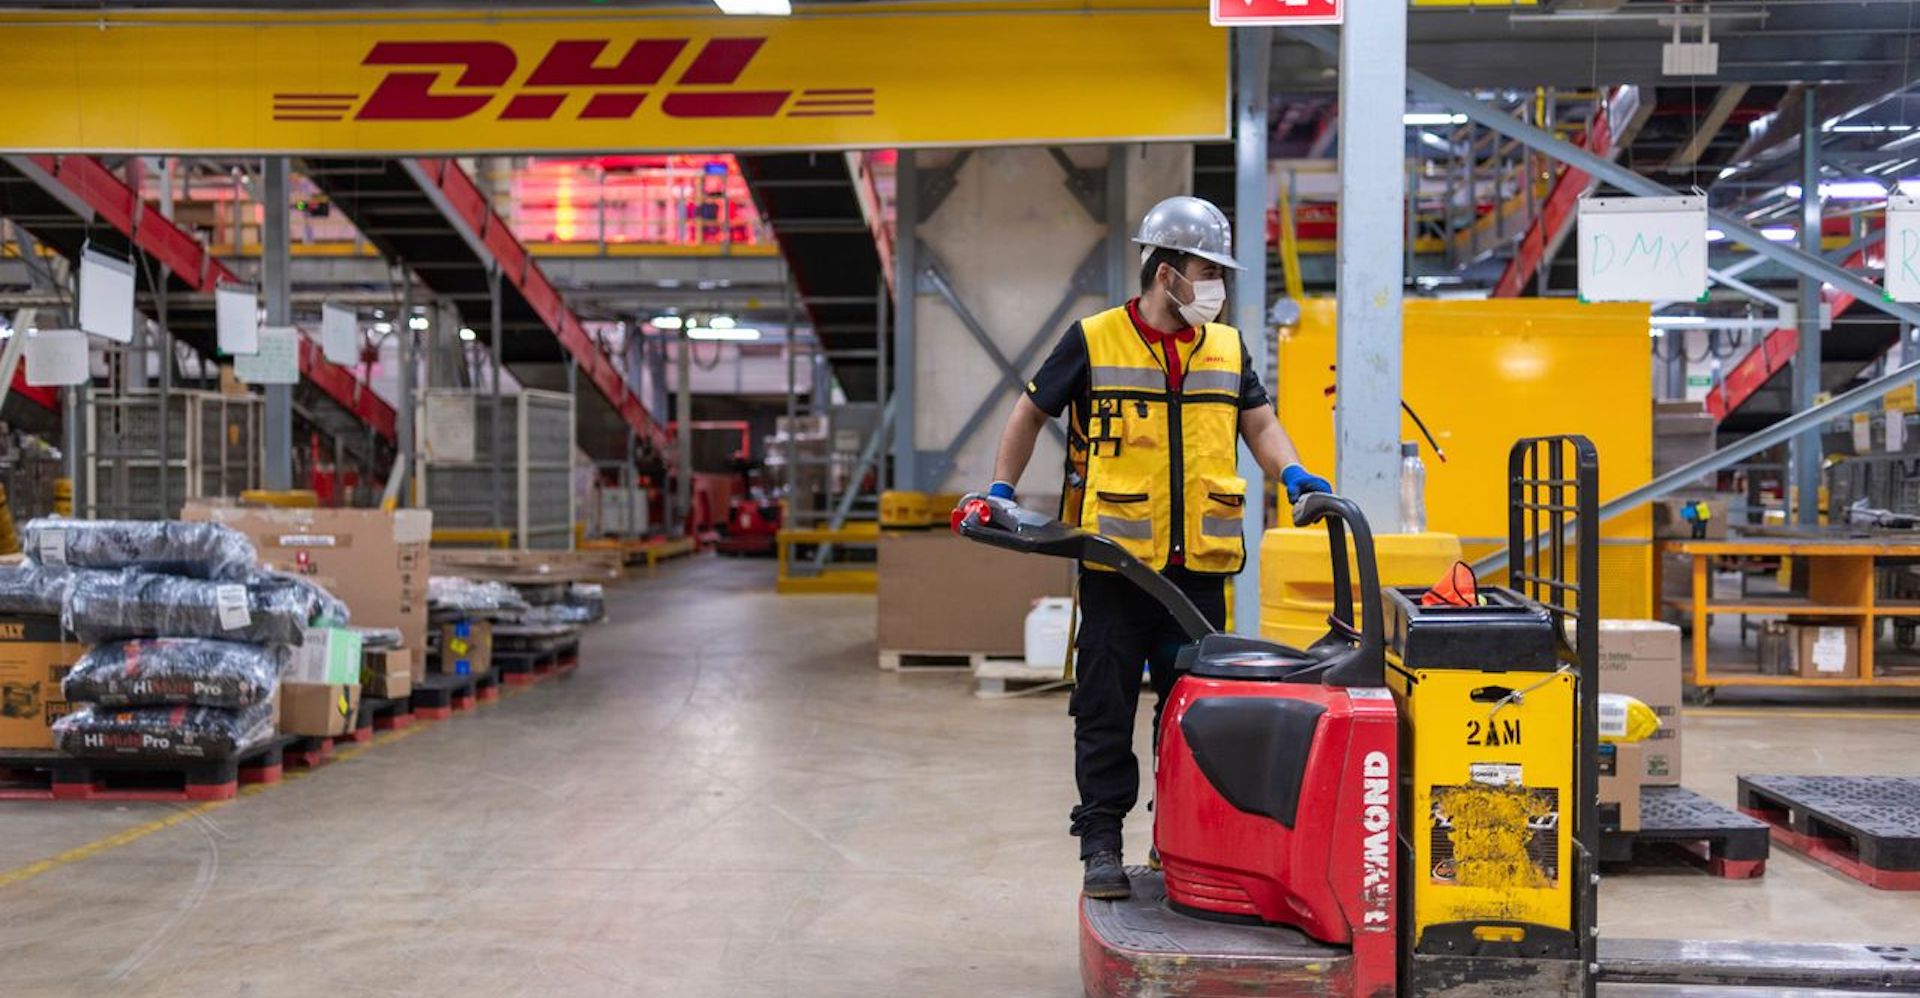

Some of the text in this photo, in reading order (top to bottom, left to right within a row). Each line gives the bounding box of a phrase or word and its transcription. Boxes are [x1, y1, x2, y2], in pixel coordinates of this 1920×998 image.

[353, 36, 794, 121] DHL
[1591, 232, 1690, 278] DMX
[133, 680, 222, 696] HiMultiPro
[84, 733, 170, 749] HiMultiPro
